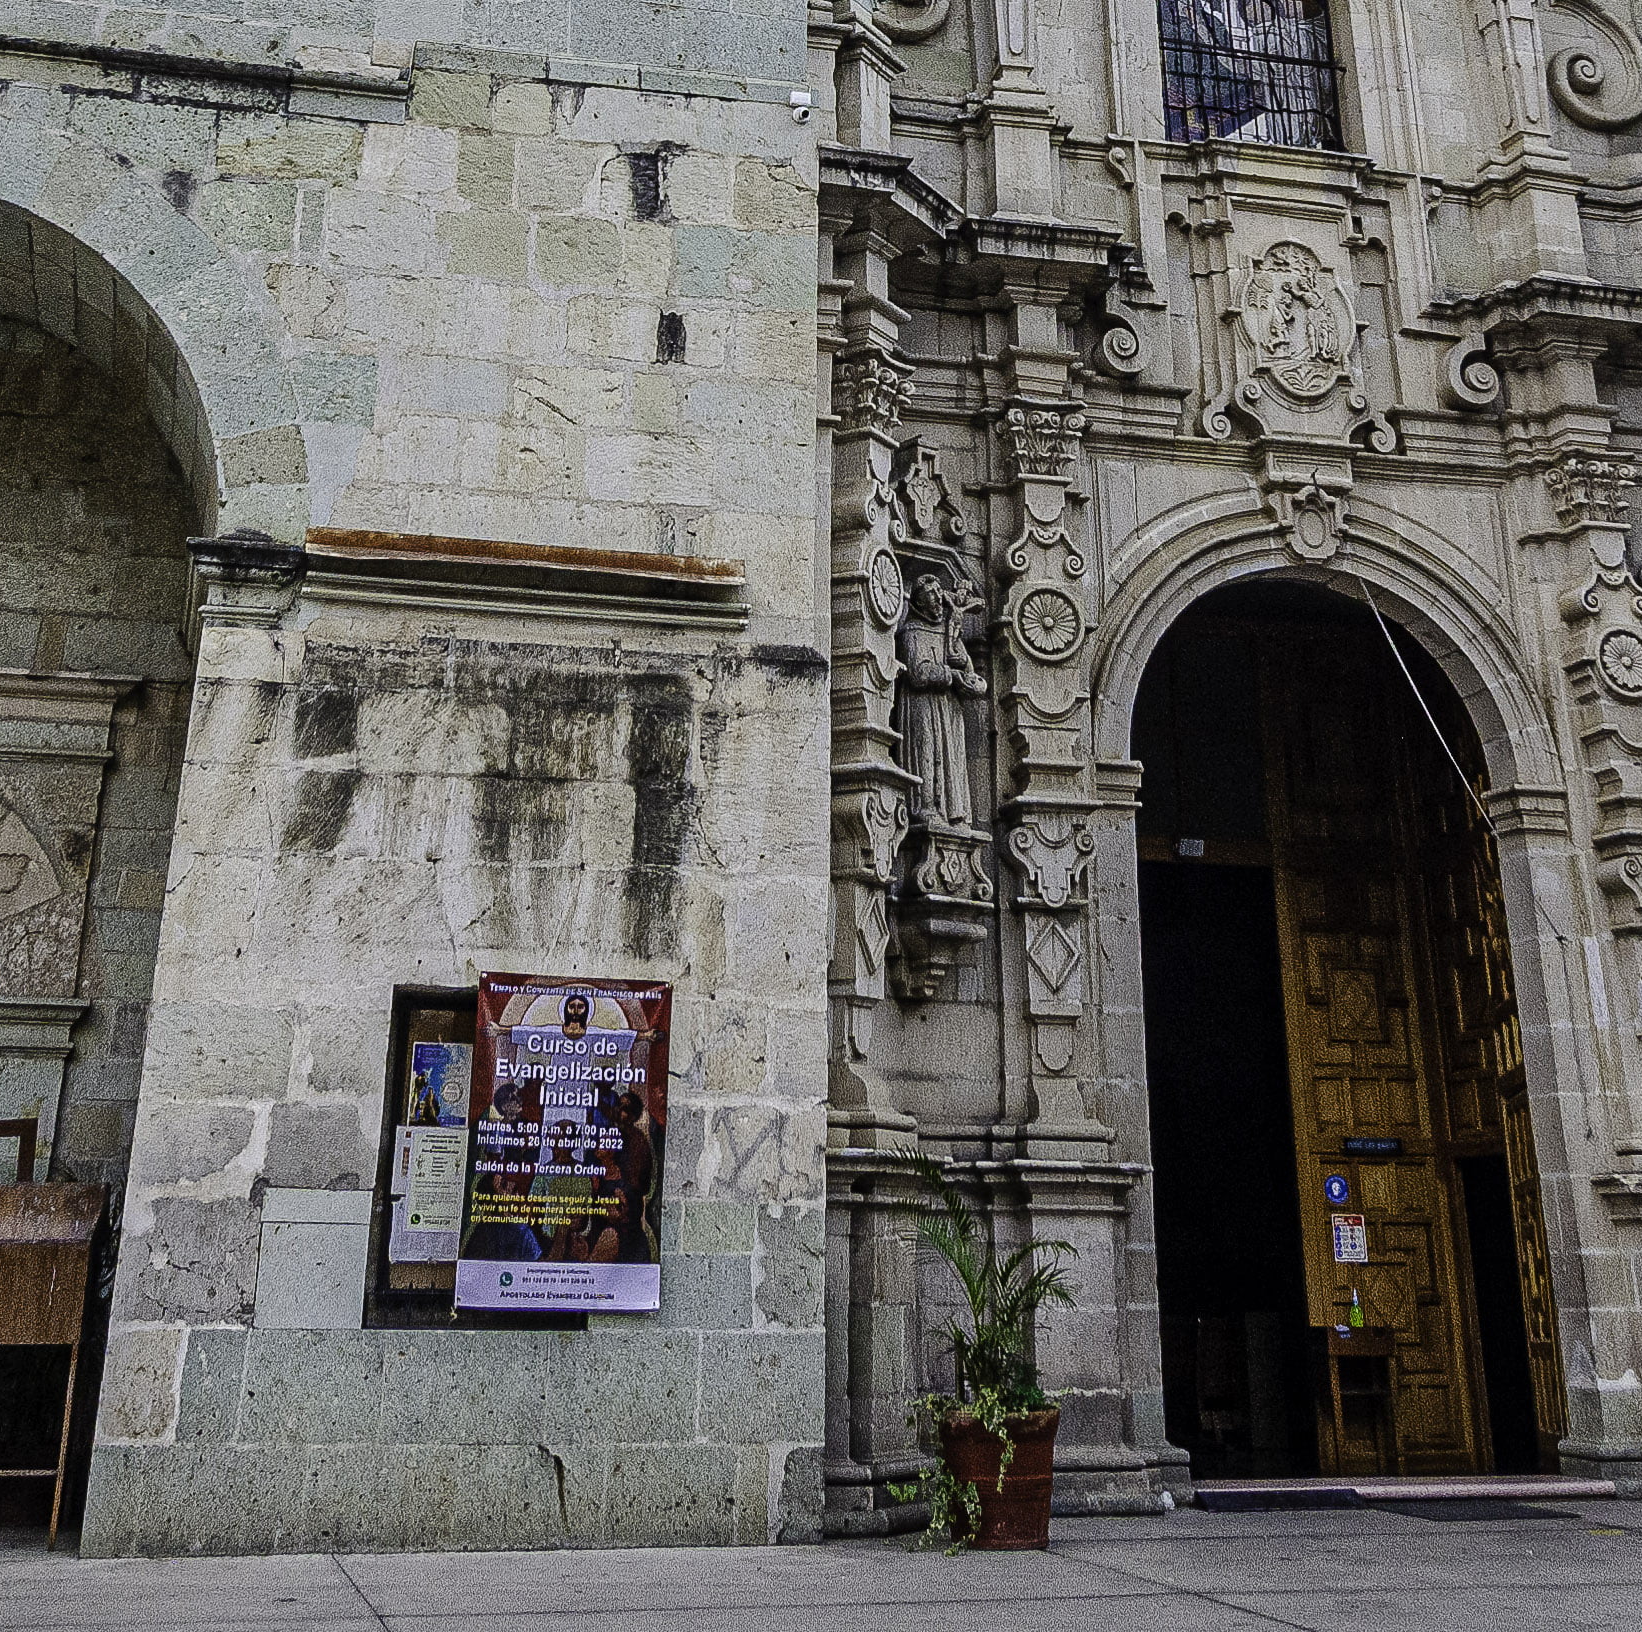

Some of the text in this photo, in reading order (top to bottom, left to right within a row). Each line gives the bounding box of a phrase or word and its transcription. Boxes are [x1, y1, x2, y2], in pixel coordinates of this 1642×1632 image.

[577, 988, 592, 997] SAN
[594, 989, 633, 998] FRANCISCO
[528, 1034, 617, 1056] Curso de
[496, 1058, 645, 1084] Evangelización
[539, 1085, 599, 1107] Inicial
[478, 1120, 514, 1134] Martes,
[518, 1122, 538, 1134] 5:00
[542, 1124, 563, 1137] p.m.
[575, 1125, 597, 1136] 7:00
[599, 1128, 621, 1138] p.m.
[477, 1134, 525, 1147] Iniciamos
[542, 1136, 555, 1147] de
[558, 1137, 581, 1148] abril
[584, 1138, 597, 1149] de
[599, 1138, 623, 1150] 2022
[475, 1160, 606, 1175] Salón de la Tercera Orden
[472, 1191, 490, 1201] Para
[493, 1193, 525, 1204] quienes
[560, 1194, 585, 1206] seguir
[479, 1203, 496, 1212] vivir
[498, 1205, 508, 1213] su
[533, 1205, 563, 1214] manera
[483, 1215, 528, 1224] comunidad
[538, 1216, 571, 1226] servicio
